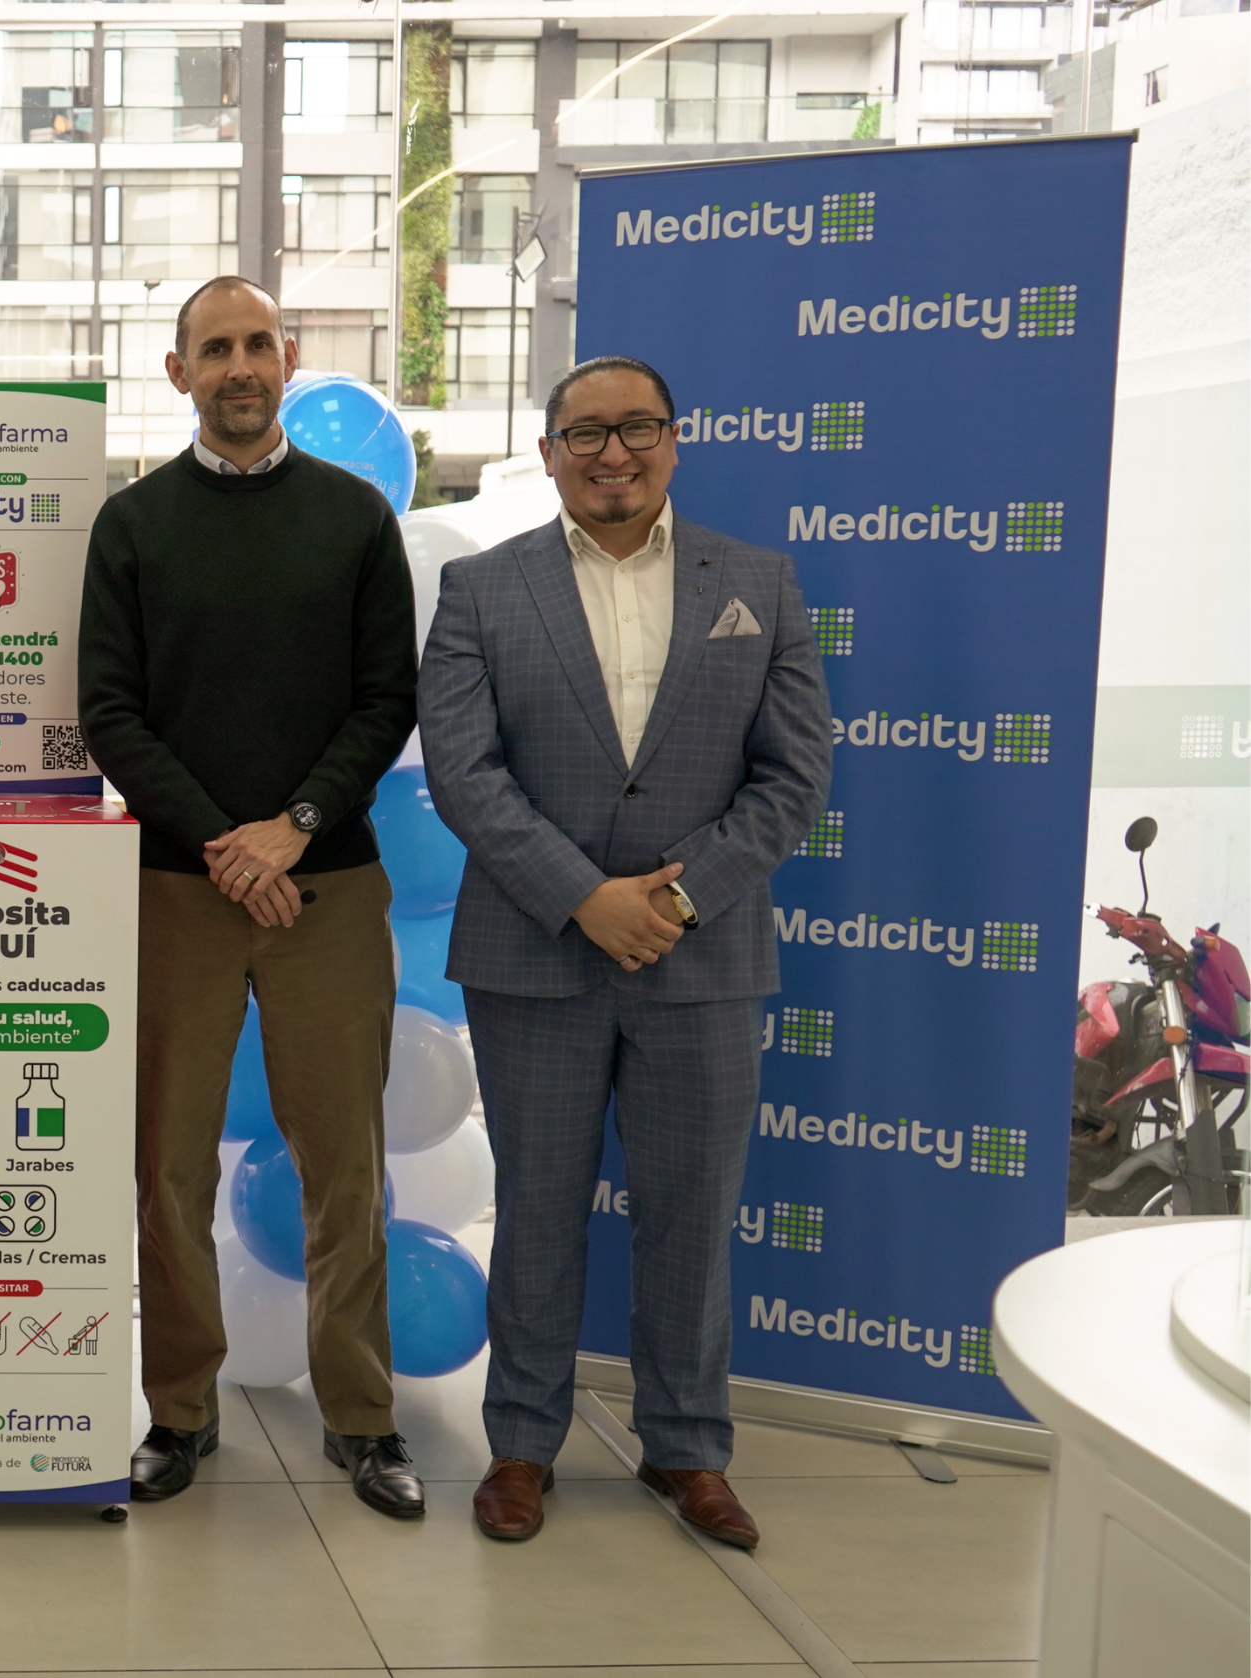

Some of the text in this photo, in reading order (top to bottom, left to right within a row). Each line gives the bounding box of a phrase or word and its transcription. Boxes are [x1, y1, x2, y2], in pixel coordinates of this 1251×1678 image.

[615, 200, 814, 247] Medicity
[798, 292, 1011, 340] Medicity
[676, 406, 804, 452] dicity
[0, 475, 21, 483] CON
[788, 504, 998, 553] Medicity
[1, 714, 14, 723] EN
[832, 710, 986, 762] edicity
[773, 907, 975, 967] Medicity
[7, 978, 106, 992] caducadas
[12, 1010, 72, 1028] salud,
[759, 1102, 963, 1169] Medicity
[5, 1158, 75, 1172] Jarabes
[39, 1251, 107, 1265] Cremas
[750, 1296, 952, 1369] Medicity
[6, 1433, 56, 1443] ambiente
[6, 1458, 21, 1468] de
[51, 1456, 90, 1464] PROYECCIÓN
[51, 1463, 92, 1472] FUTURA
